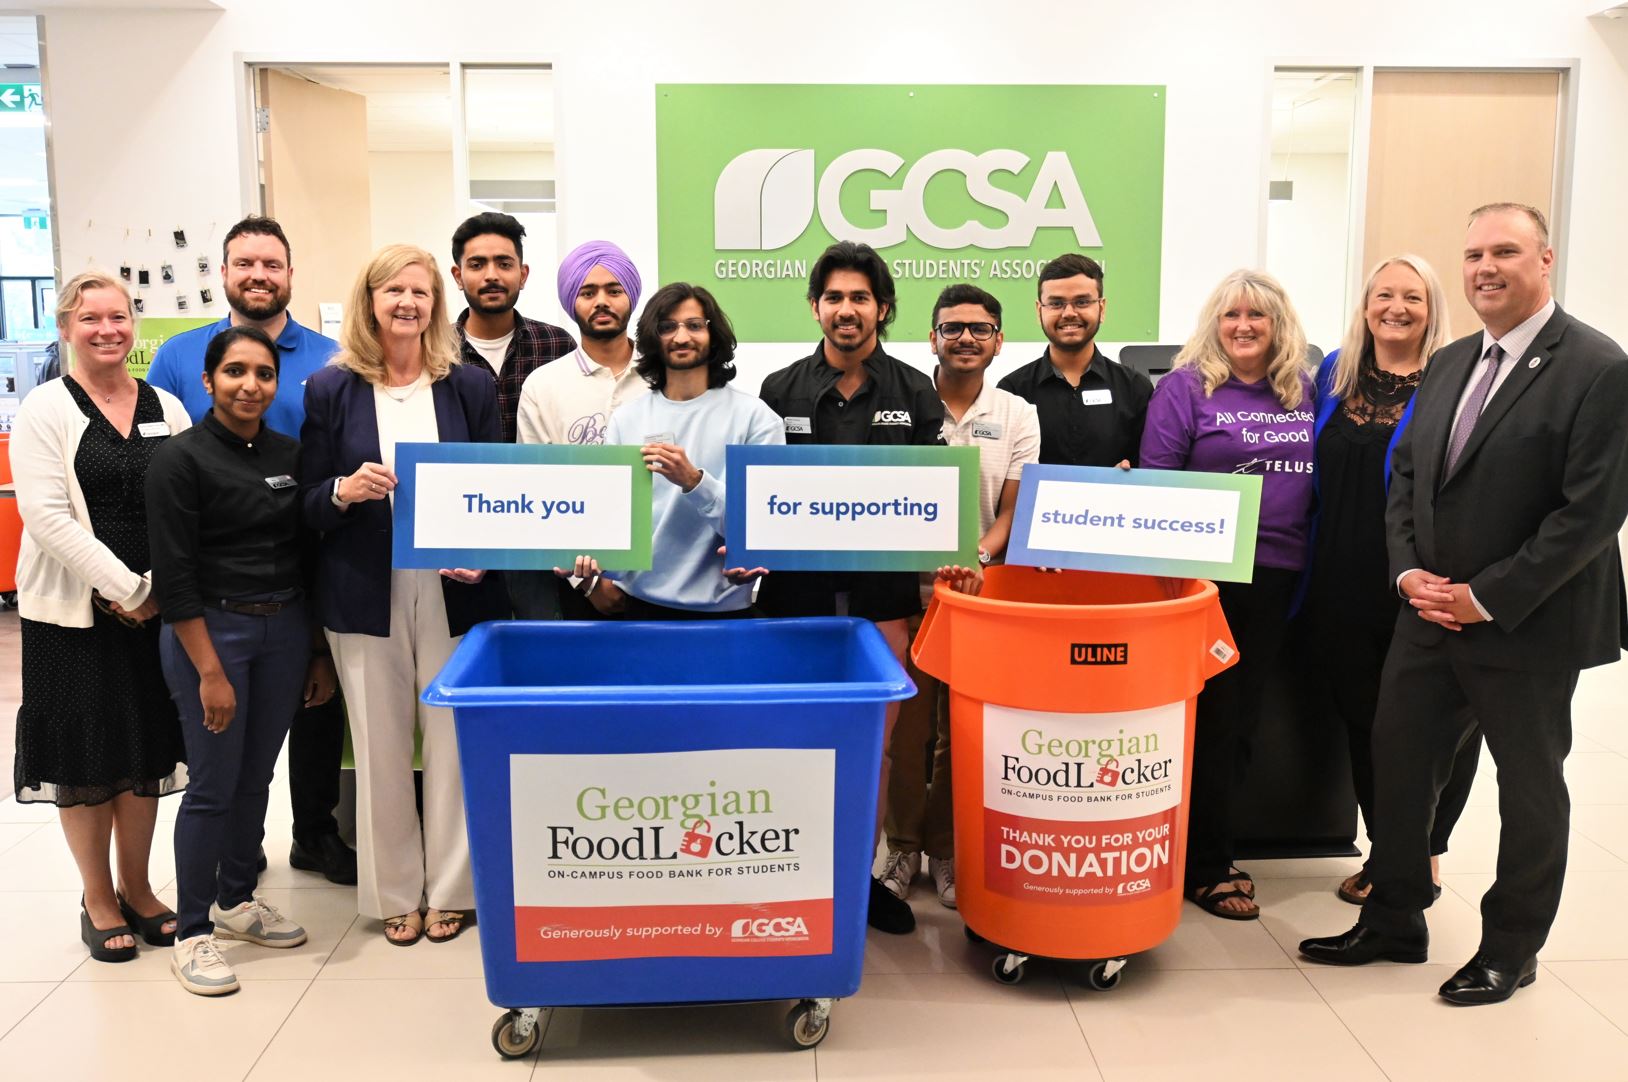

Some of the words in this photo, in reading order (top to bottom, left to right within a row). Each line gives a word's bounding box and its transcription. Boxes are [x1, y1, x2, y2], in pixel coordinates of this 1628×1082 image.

[817, 148, 1104, 250] GCSA
[714, 258, 807, 279] GEORGIAN
[893, 259, 985, 279] STUDENTS'
[881, 410, 912, 423] GCSA
[1216, 411, 1236, 426] All
[1237, 409, 1315, 423] Connected
[1241, 427, 1260, 444] for
[1264, 428, 1310, 443] Good
[1264, 460, 1314, 474] TELUS
[462, 493, 534, 515] Thank
[540, 498, 586, 520] you
[767, 494, 803, 516] for
[809, 496, 939, 521] supporting
[1040, 508, 1126, 529] student
[1131, 516, 1226, 535] success!
[1074, 646, 1125, 663] ULINE
[1021, 728, 1160, 766] Georgian
[1000, 787, 1054, 802] ON-CAMPUS
[1057, 795, 1084, 803] FOOD
[1086, 795, 1113, 803] BANK
[1115, 793, 1133, 801] FOR
[1135, 784, 1172, 799] STUDENTS
[576, 780, 774, 830] Georgian
[1001, 826, 1056, 847] THANK
[1060, 835, 1097, 848] YOU
[1102, 832, 1133, 848] FOR
[1136, 823, 1170, 843] YOUR
[1000, 839, 1170, 878] DONATION
[547, 869, 624, 880] ON-CAMPUS
[628, 870, 664, 879] FOOD
[668, 869, 703, 879] BANK
[707, 867, 733, 877] FOR
[737, 862, 801, 876] STUDENTS
[1023, 882, 1064, 896] Generously
[1065, 886, 1104, 896] supported
[1104, 885, 1114, 895] by
[1126, 877, 1151, 893] GCSA
[540, 925, 622, 940] Generously
[626, 923, 702, 939] supported
[705, 922, 724, 938] by
[751, 916, 809, 938] GCSA
